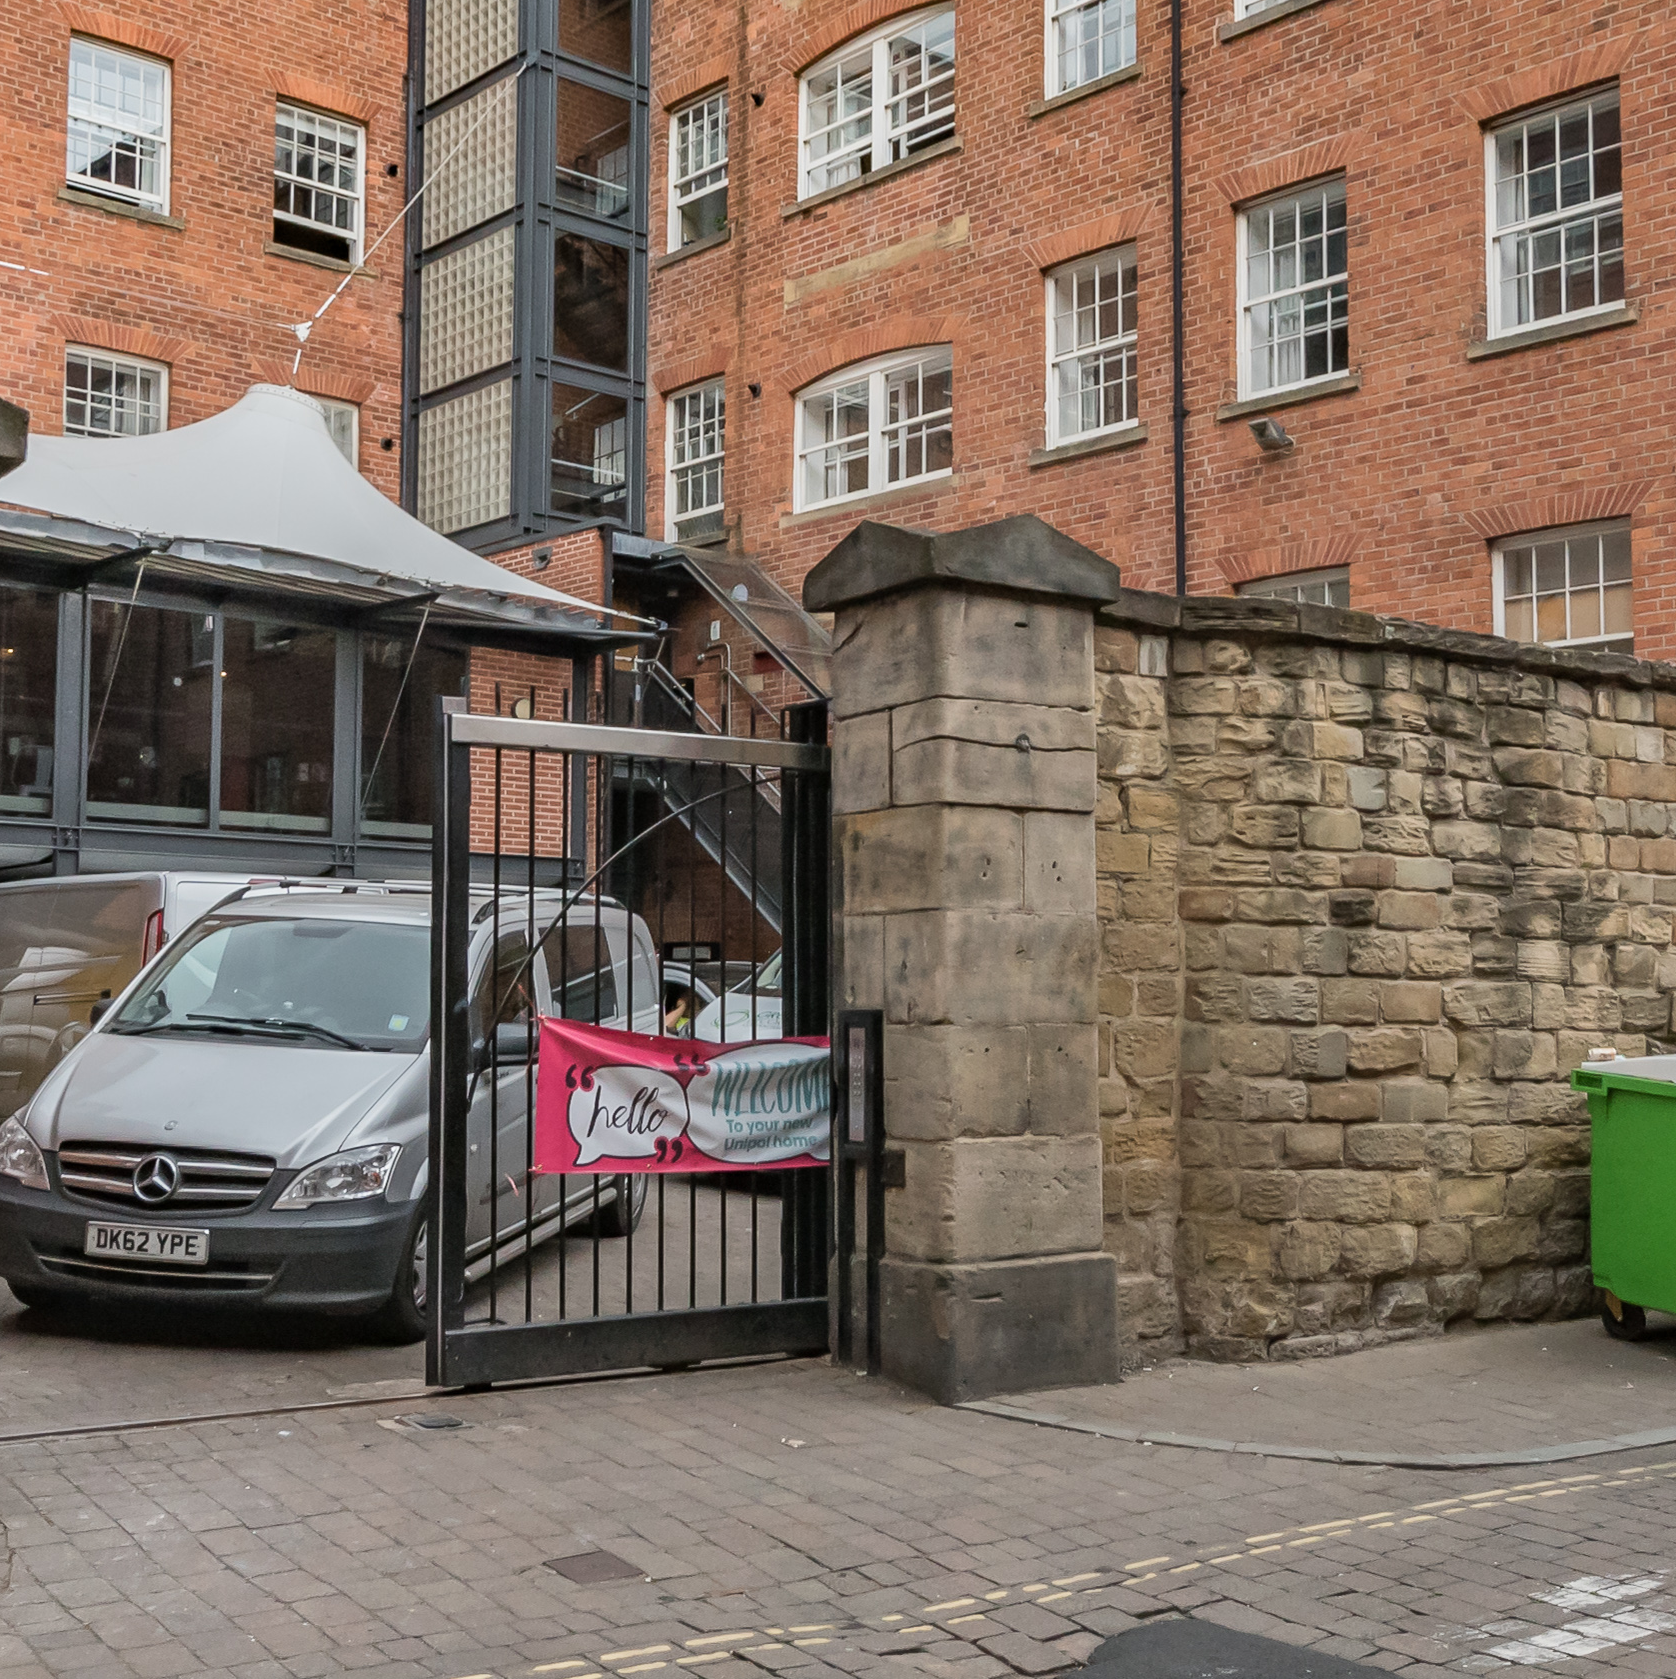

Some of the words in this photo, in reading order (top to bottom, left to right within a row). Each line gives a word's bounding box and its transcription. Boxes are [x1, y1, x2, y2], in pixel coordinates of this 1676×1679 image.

[586, 1085, 669, 1138] hello
[726, 1119, 743, 1133] To
[747, 1120, 780, 1136] your
[783, 1117, 814, 1131] new
[724, 1134, 772, 1152] Unipol
[773, 1134, 818, 1149] home
[95, 1227, 150, 1253] DK62
[156, 1232, 199, 1256] YPE
